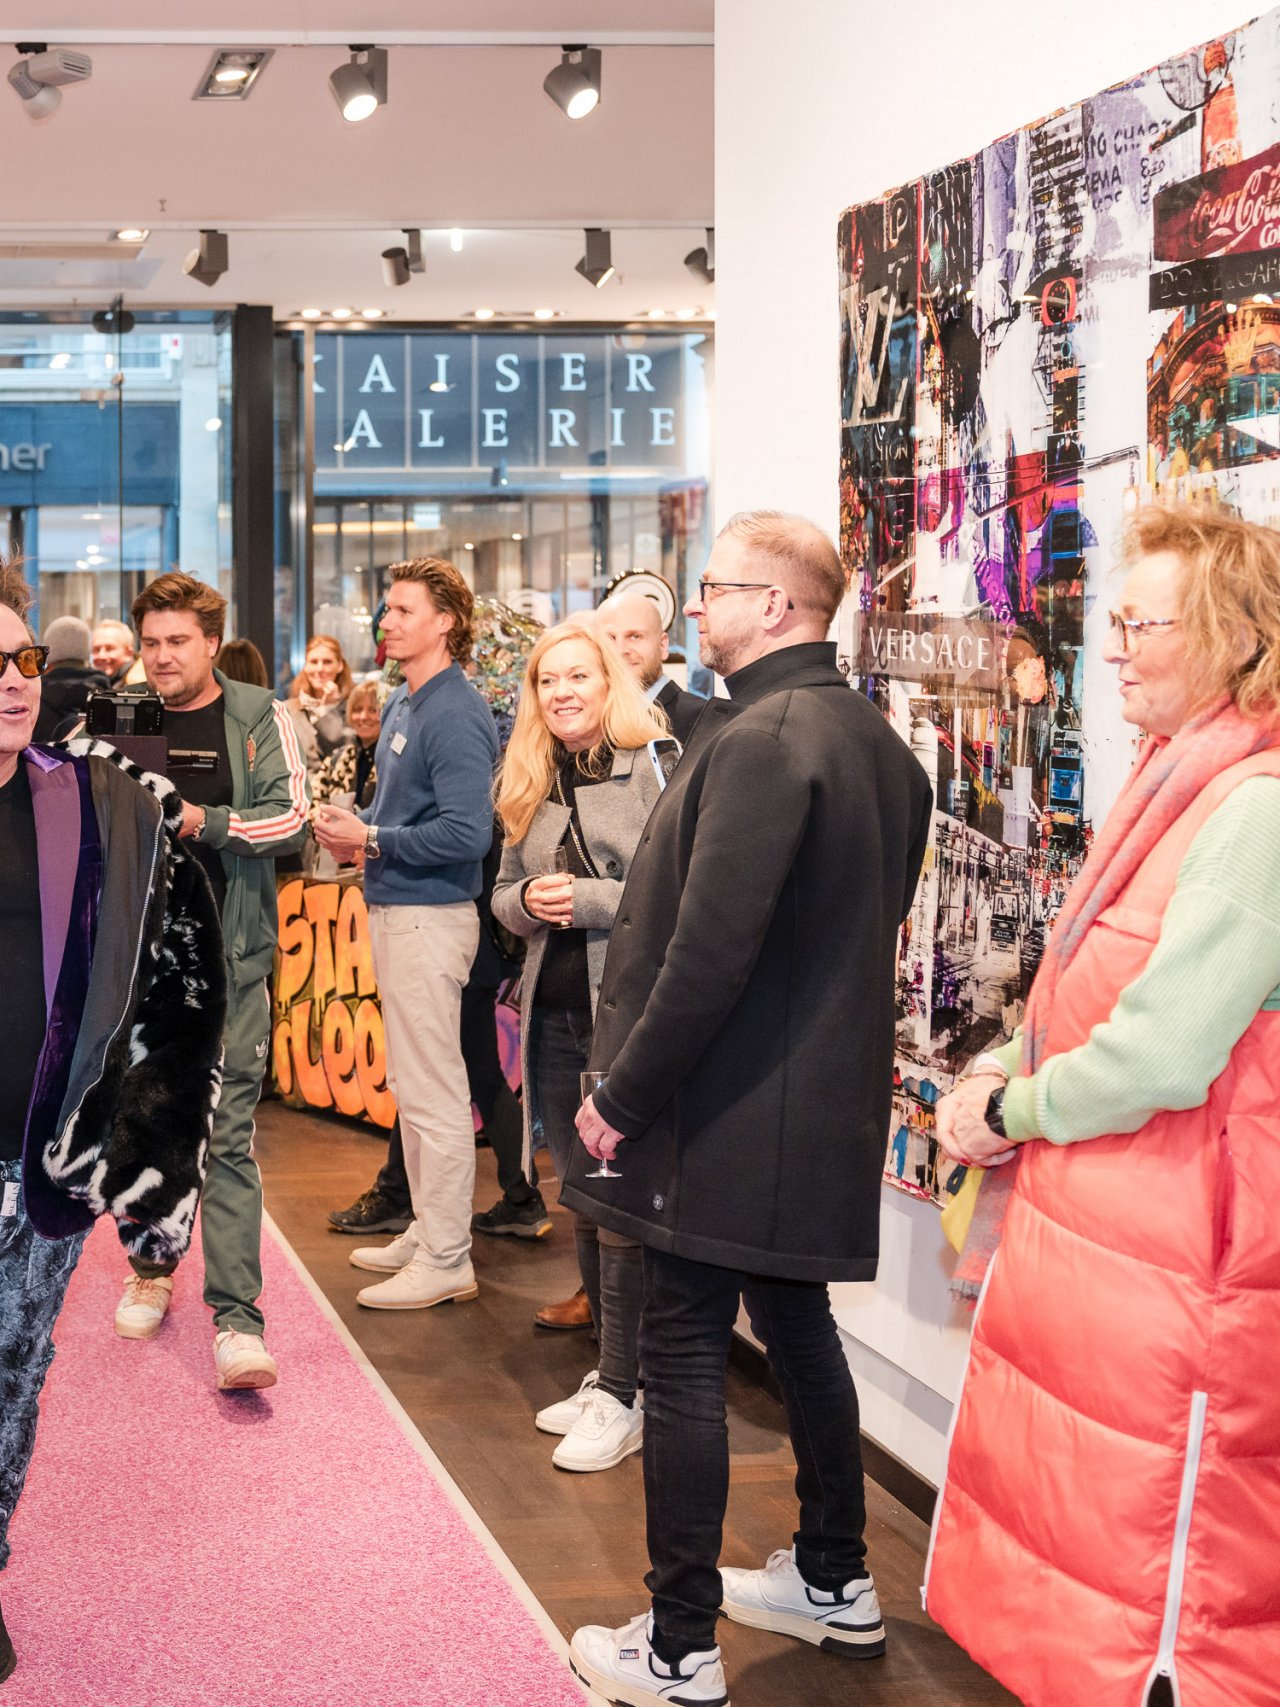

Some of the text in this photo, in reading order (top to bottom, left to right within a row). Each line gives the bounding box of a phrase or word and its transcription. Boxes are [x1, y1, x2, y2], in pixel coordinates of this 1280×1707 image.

[352, 408, 676, 448] ALERIE
[869, 626, 990, 671] VERSACE
[277, 879, 378, 1002] STA
